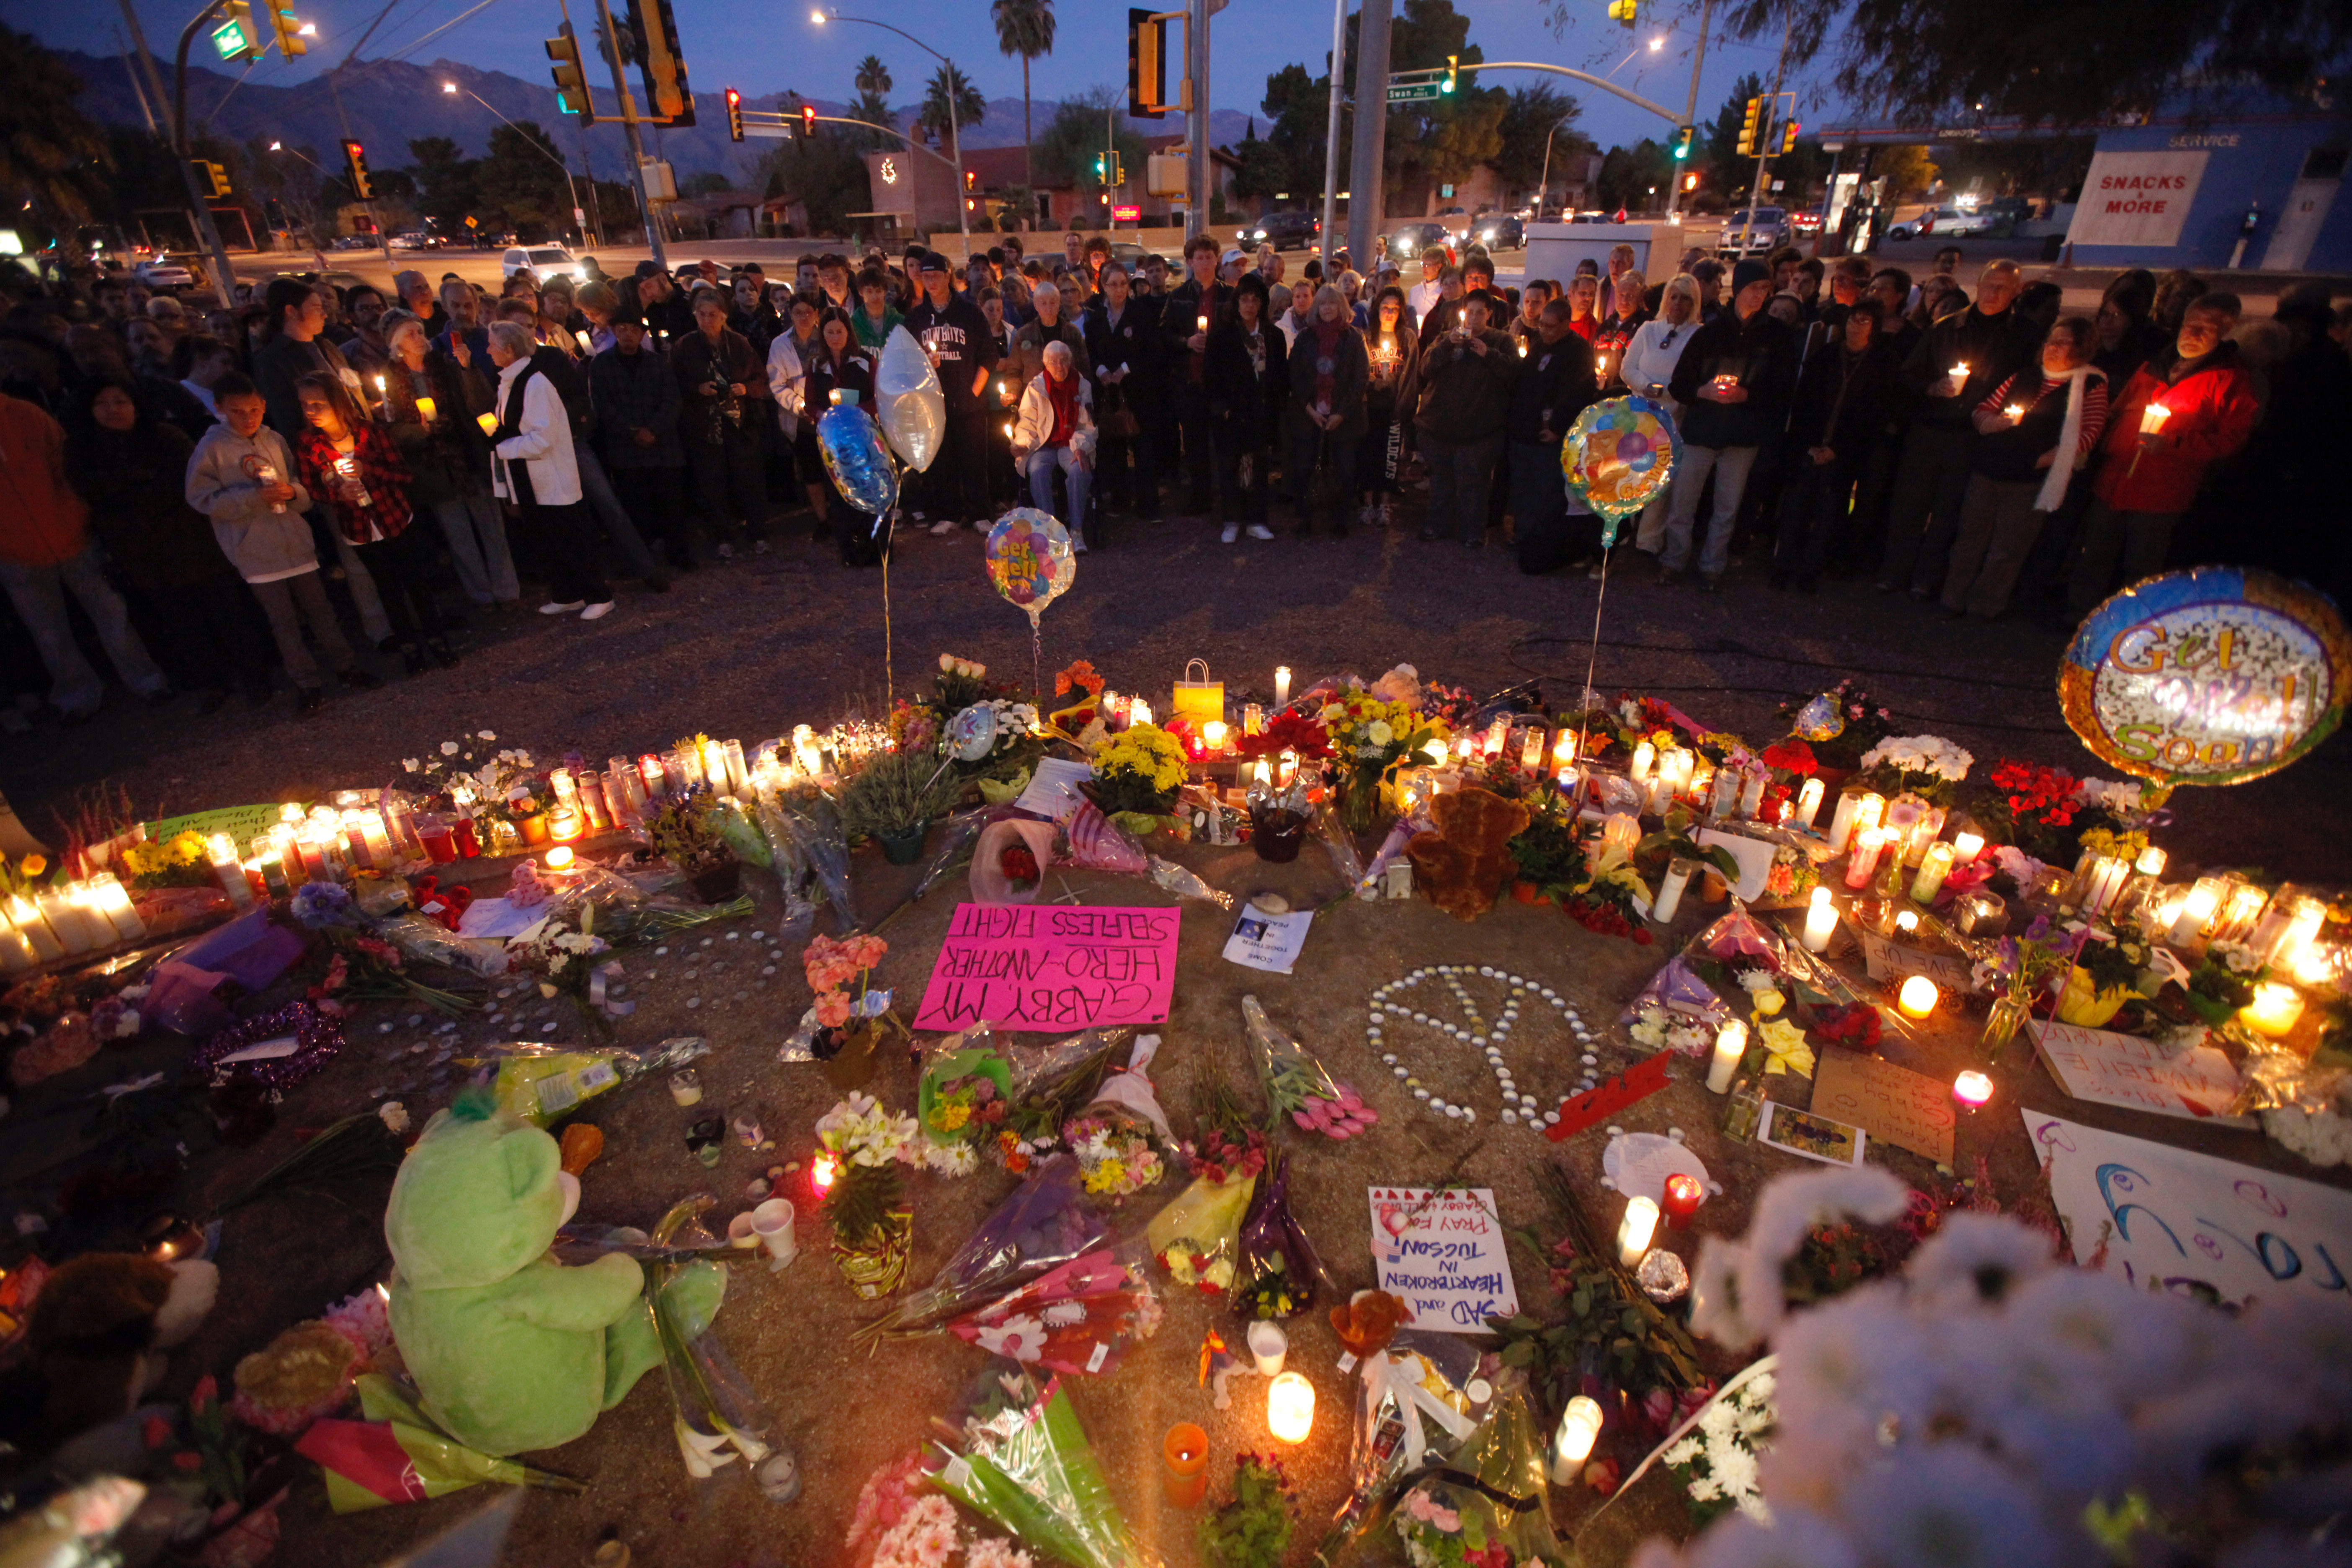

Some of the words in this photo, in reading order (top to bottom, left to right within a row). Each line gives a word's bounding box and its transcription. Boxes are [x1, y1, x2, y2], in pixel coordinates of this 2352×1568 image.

[2169, 135, 2240, 147] SERVICE
[2100, 176, 2186, 189] SNACKS
[2104, 200, 2167, 214] MORE
[1385, 422, 1401, 480] WILDCATS
[1620, 477, 1652, 499] Get
[1646, 442, 1670, 483] Well
[996, 535, 1031, 559] Get
[2109, 623, 2243, 674] Get
[209, 809, 253, 820] Bless
[947, 907, 1035, 939] FIGHT
[1052, 911, 1176, 942] SELFLESS
[1261, 918, 1289, 928] PEACE
[1242, 939, 1288, 953] TOGETHER
[1873, 944, 1902, 965] UP
[942, 946, 1049, 981] ANOTHER
[1066, 946, 1160, 982] HERO
[1248, 953, 1273, 964] COME
[920, 982, 988, 1022] MY
[1864, 1083, 1950, 1126] Gabby
[1827, 1101, 1941, 1157] Republicans
[1441, 1200, 1488, 1214] GABBY
[1440, 1216, 1489, 1235] PRAY
[1439, 1260, 1459, 1274] IN
[1385, 1272, 1504, 1295] HEARTBROKEN
[1413, 1298, 1446, 1316] and
[1451, 1298, 1499, 1326] SAD
